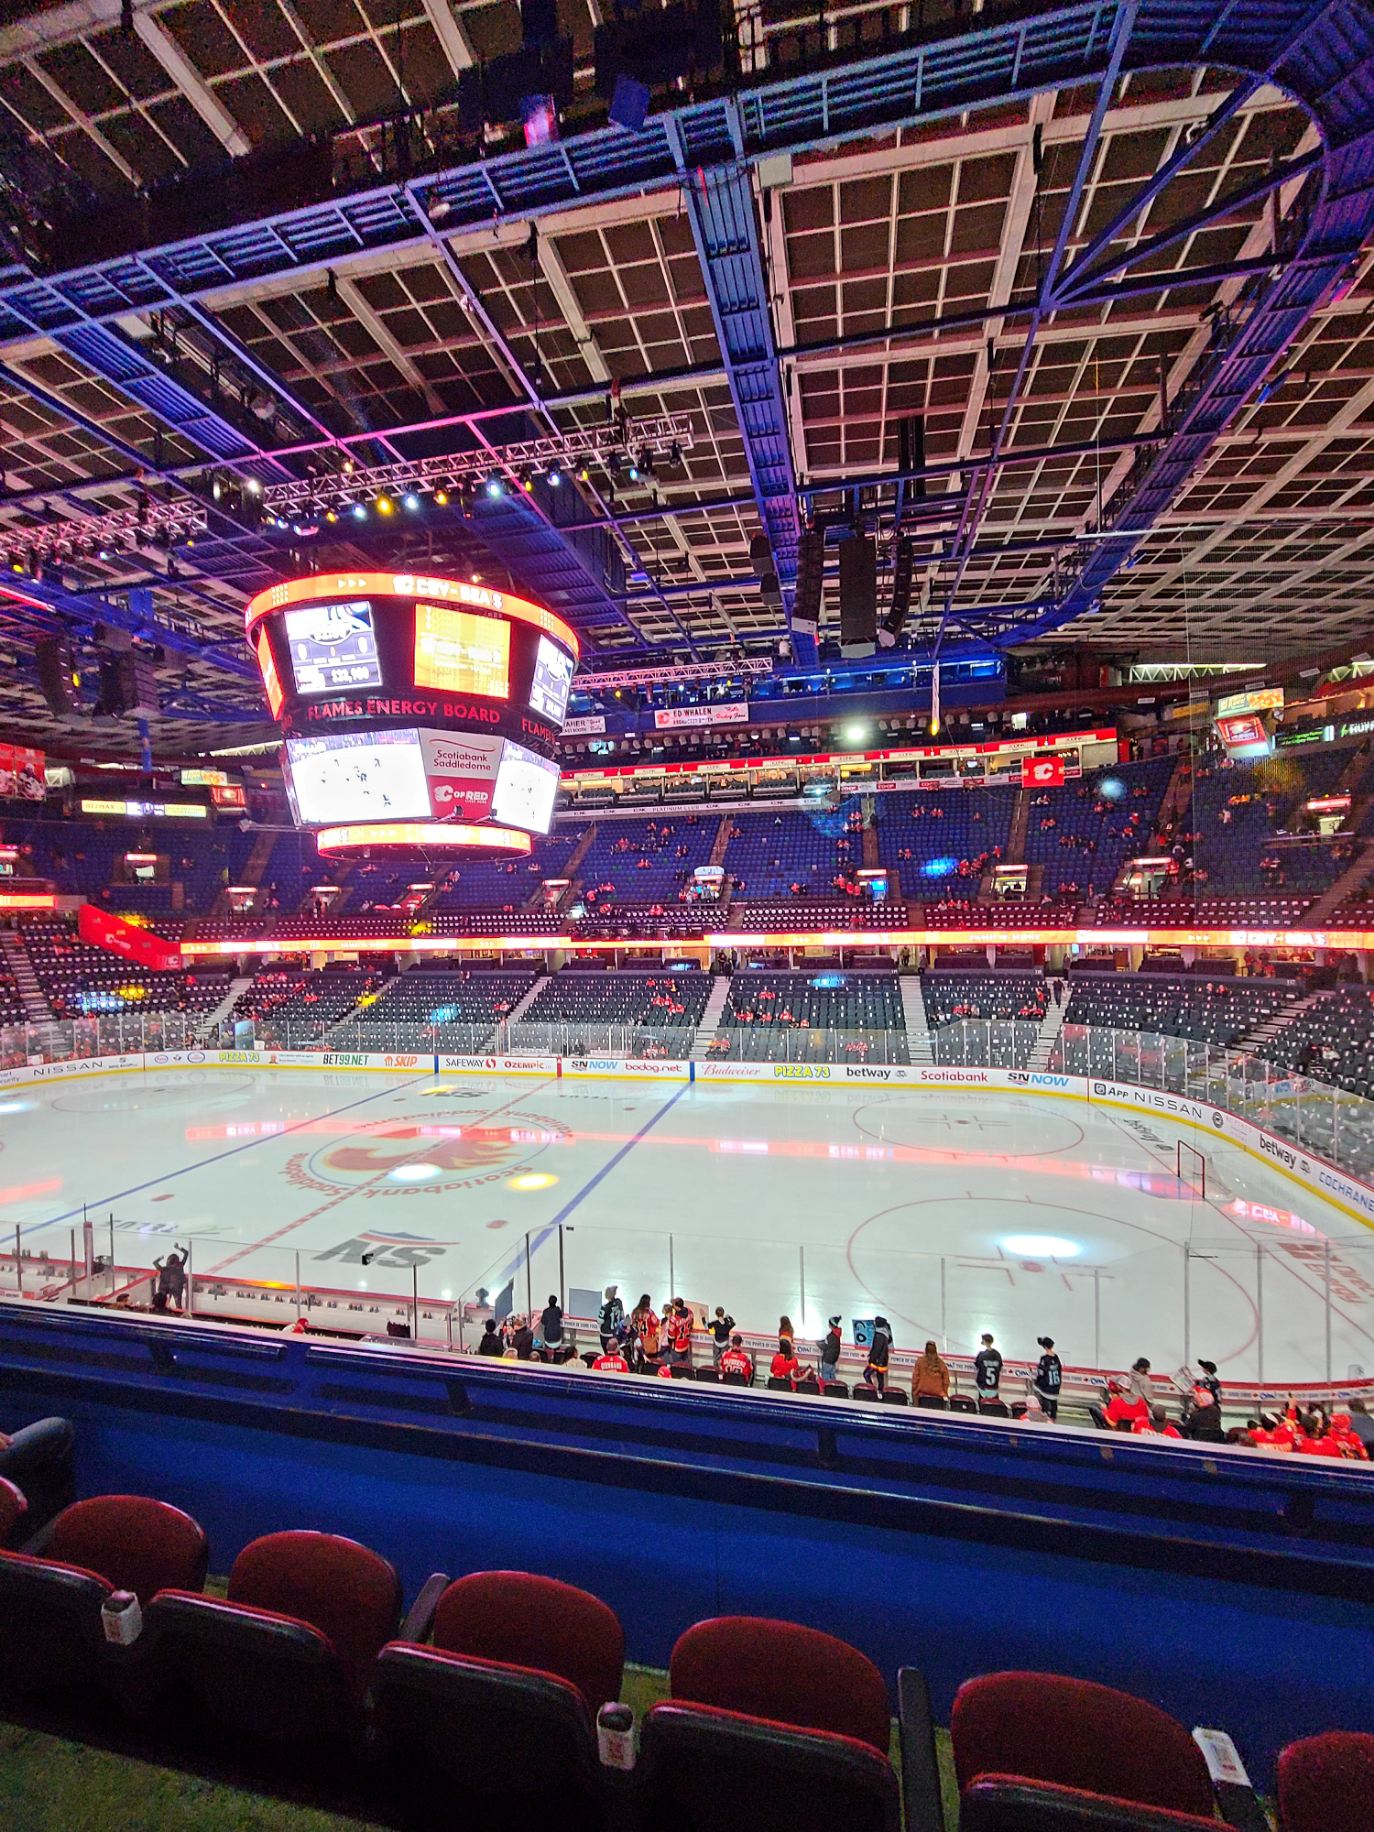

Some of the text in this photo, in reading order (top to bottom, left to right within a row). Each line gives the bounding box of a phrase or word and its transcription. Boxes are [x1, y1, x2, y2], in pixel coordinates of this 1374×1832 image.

[307, 699, 500, 724] FLAMES ENERGY BOARD
[684, 708, 712, 717] WHALEN
[522, 718, 556, 743] FLAMES
[563, 720, 586, 728] AHER
[436, 749, 488, 763] Scotiabank
[433, 760, 491, 773] Saddledome
[466, 790, 489, 801] RED
[219, 1053, 260, 1063] PIZZA 73
[323, 1053, 370, 1067] BET99.NET
[394, 1055, 418, 1068] SKIP
[445, 1058, 485, 1069] SAFEWAY
[33, 1061, 103, 1077] NISSAN
[589, 1061, 618, 1070] NOW
[625, 1062, 682, 1074] bodog.net
[703, 1062, 760, 1076] Budweiser
[773, 1065, 831, 1079] PIZZA 73
[846, 1067, 892, 1081] betway
[921, 1070, 988, 1083] Scotiabank
[1031, 1074, 1069, 1088] NOW
[1134, 1091, 1203, 1119] NISSAN
[1259, 1133, 1297, 1171] betway
[985, 1367, 996, 1386] 5
